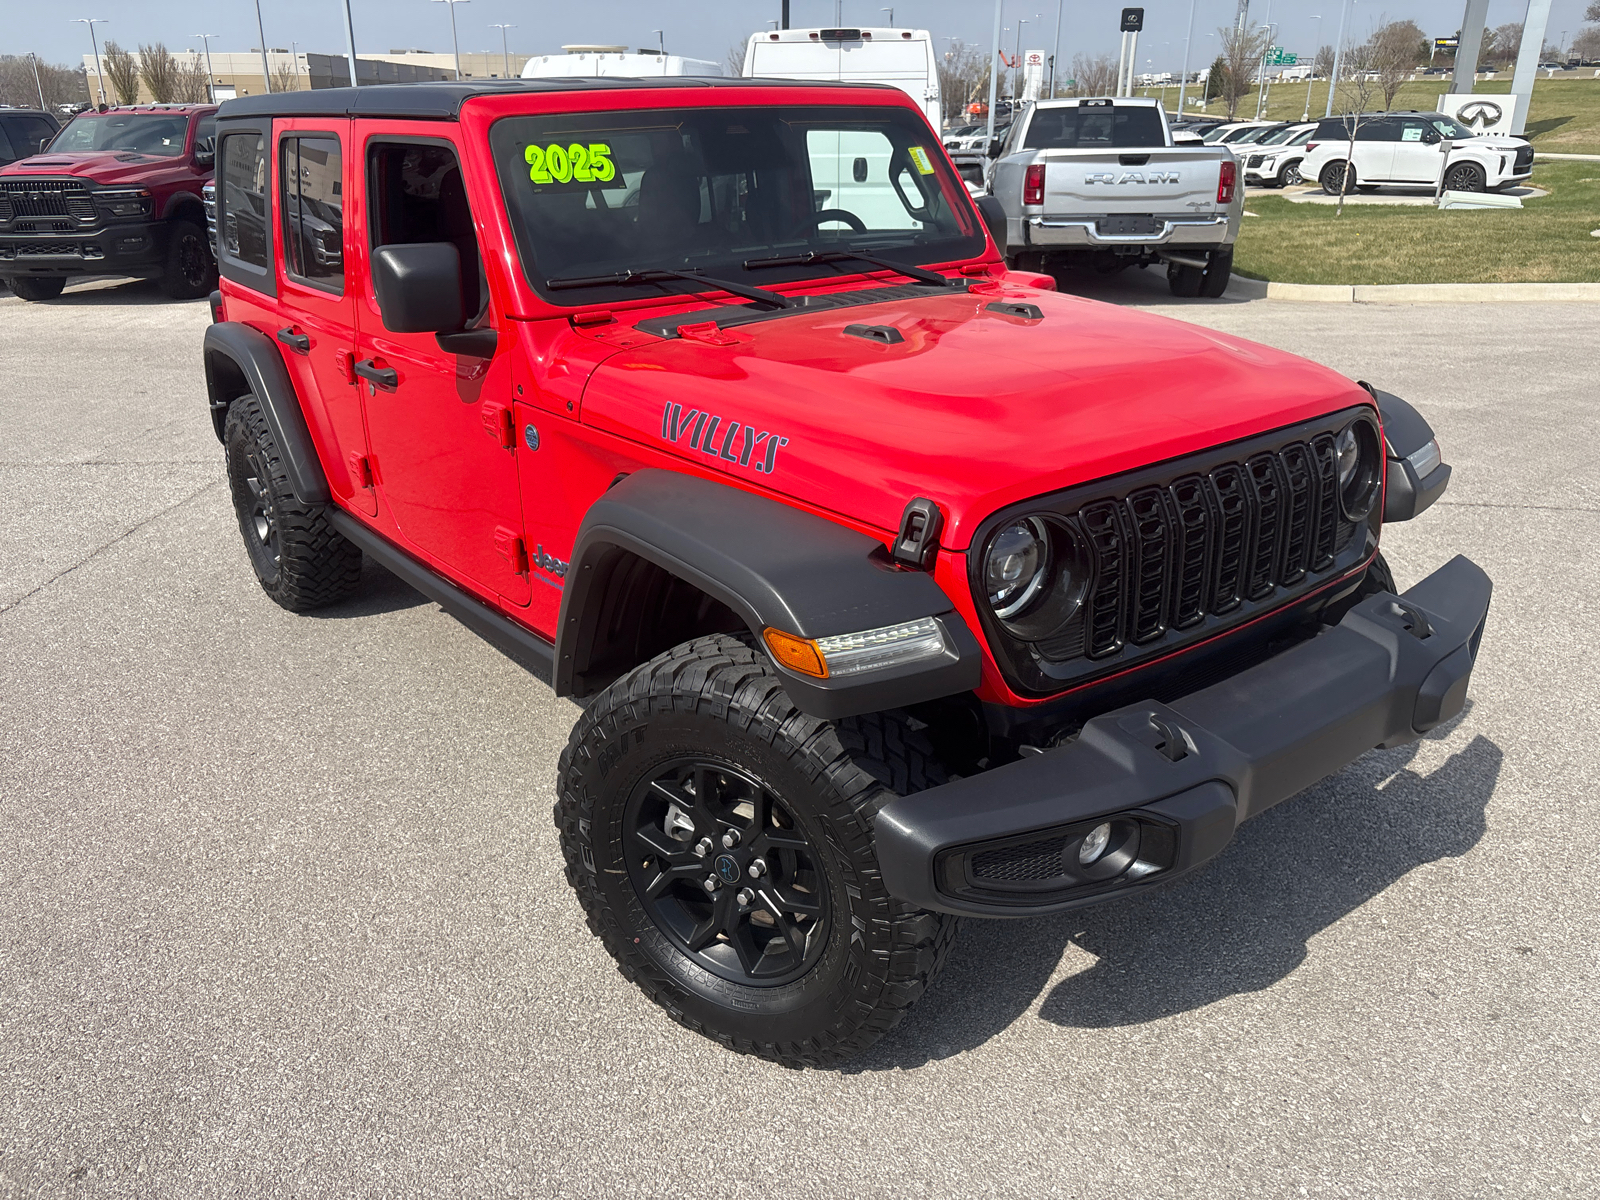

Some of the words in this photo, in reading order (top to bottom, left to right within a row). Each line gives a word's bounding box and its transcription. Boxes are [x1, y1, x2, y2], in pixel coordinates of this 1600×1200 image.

[525, 143, 615, 184] 2025
[1085, 172, 1180, 185] RAM
[662, 401, 789, 474] WILLYS
[577, 786, 691, 1004] WILDPEAK
